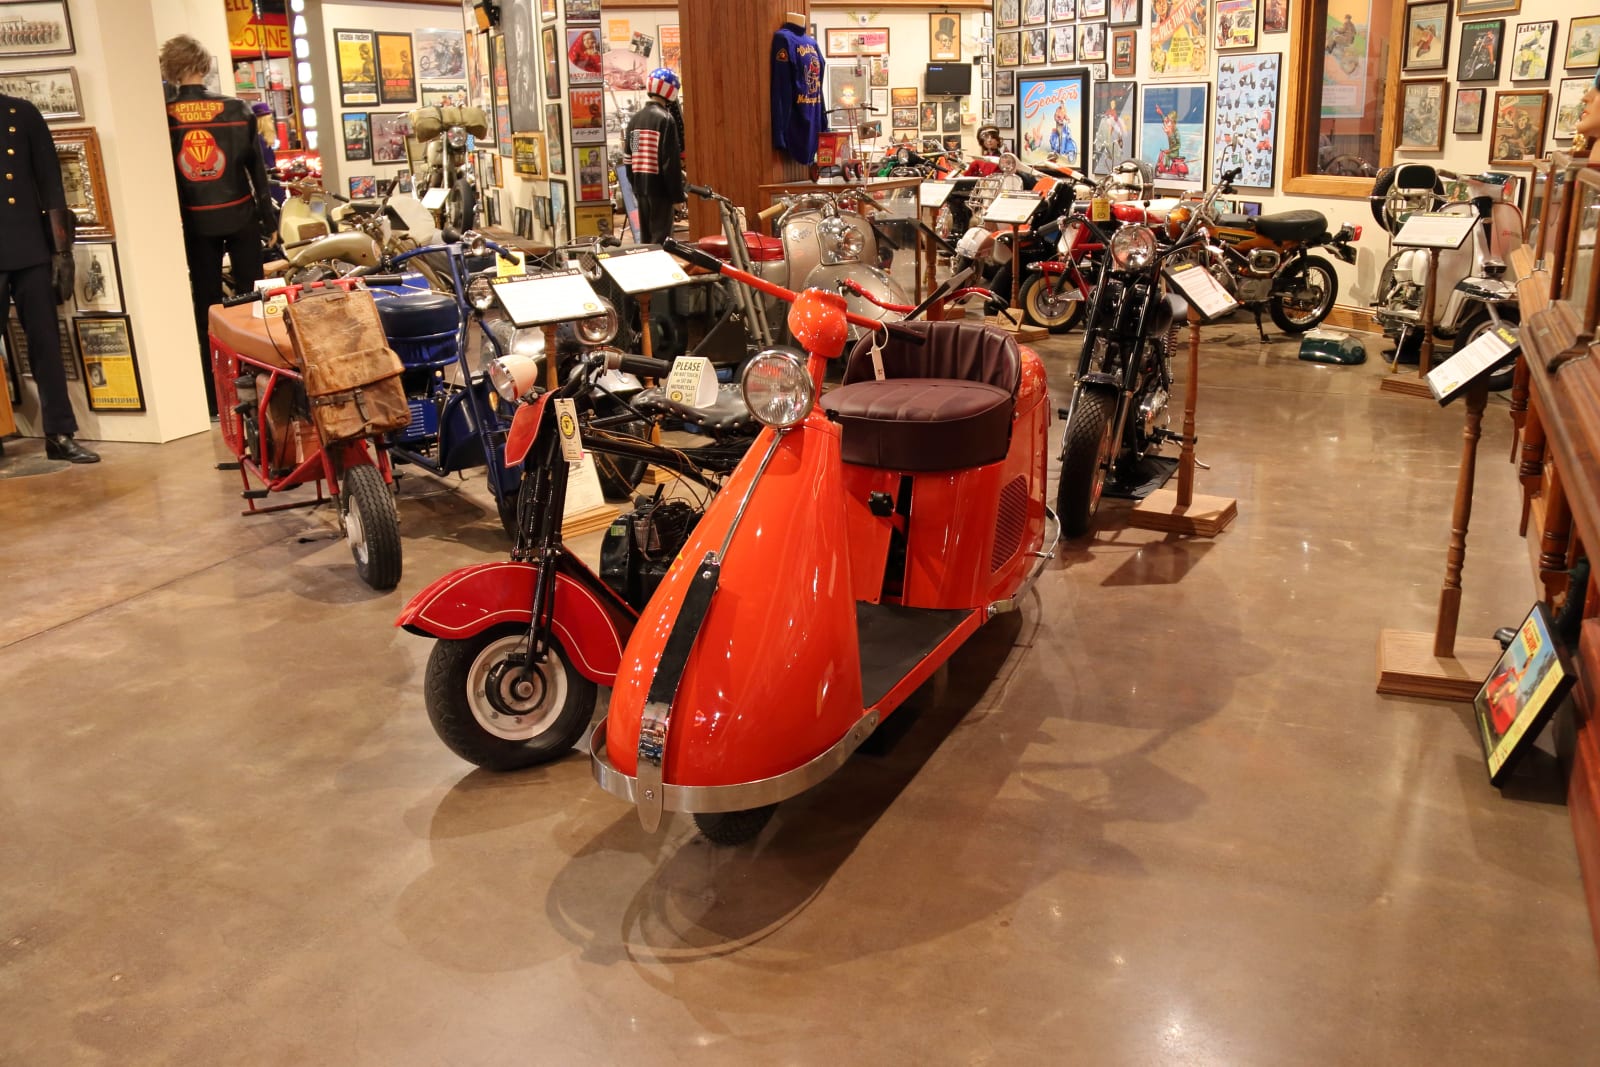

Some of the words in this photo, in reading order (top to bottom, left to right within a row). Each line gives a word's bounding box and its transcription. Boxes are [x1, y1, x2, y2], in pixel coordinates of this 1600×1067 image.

[1024, 82, 1078, 119] Scooters
[181, 112, 212, 121] TOOLS
[676, 361, 701, 371] PLEASE
